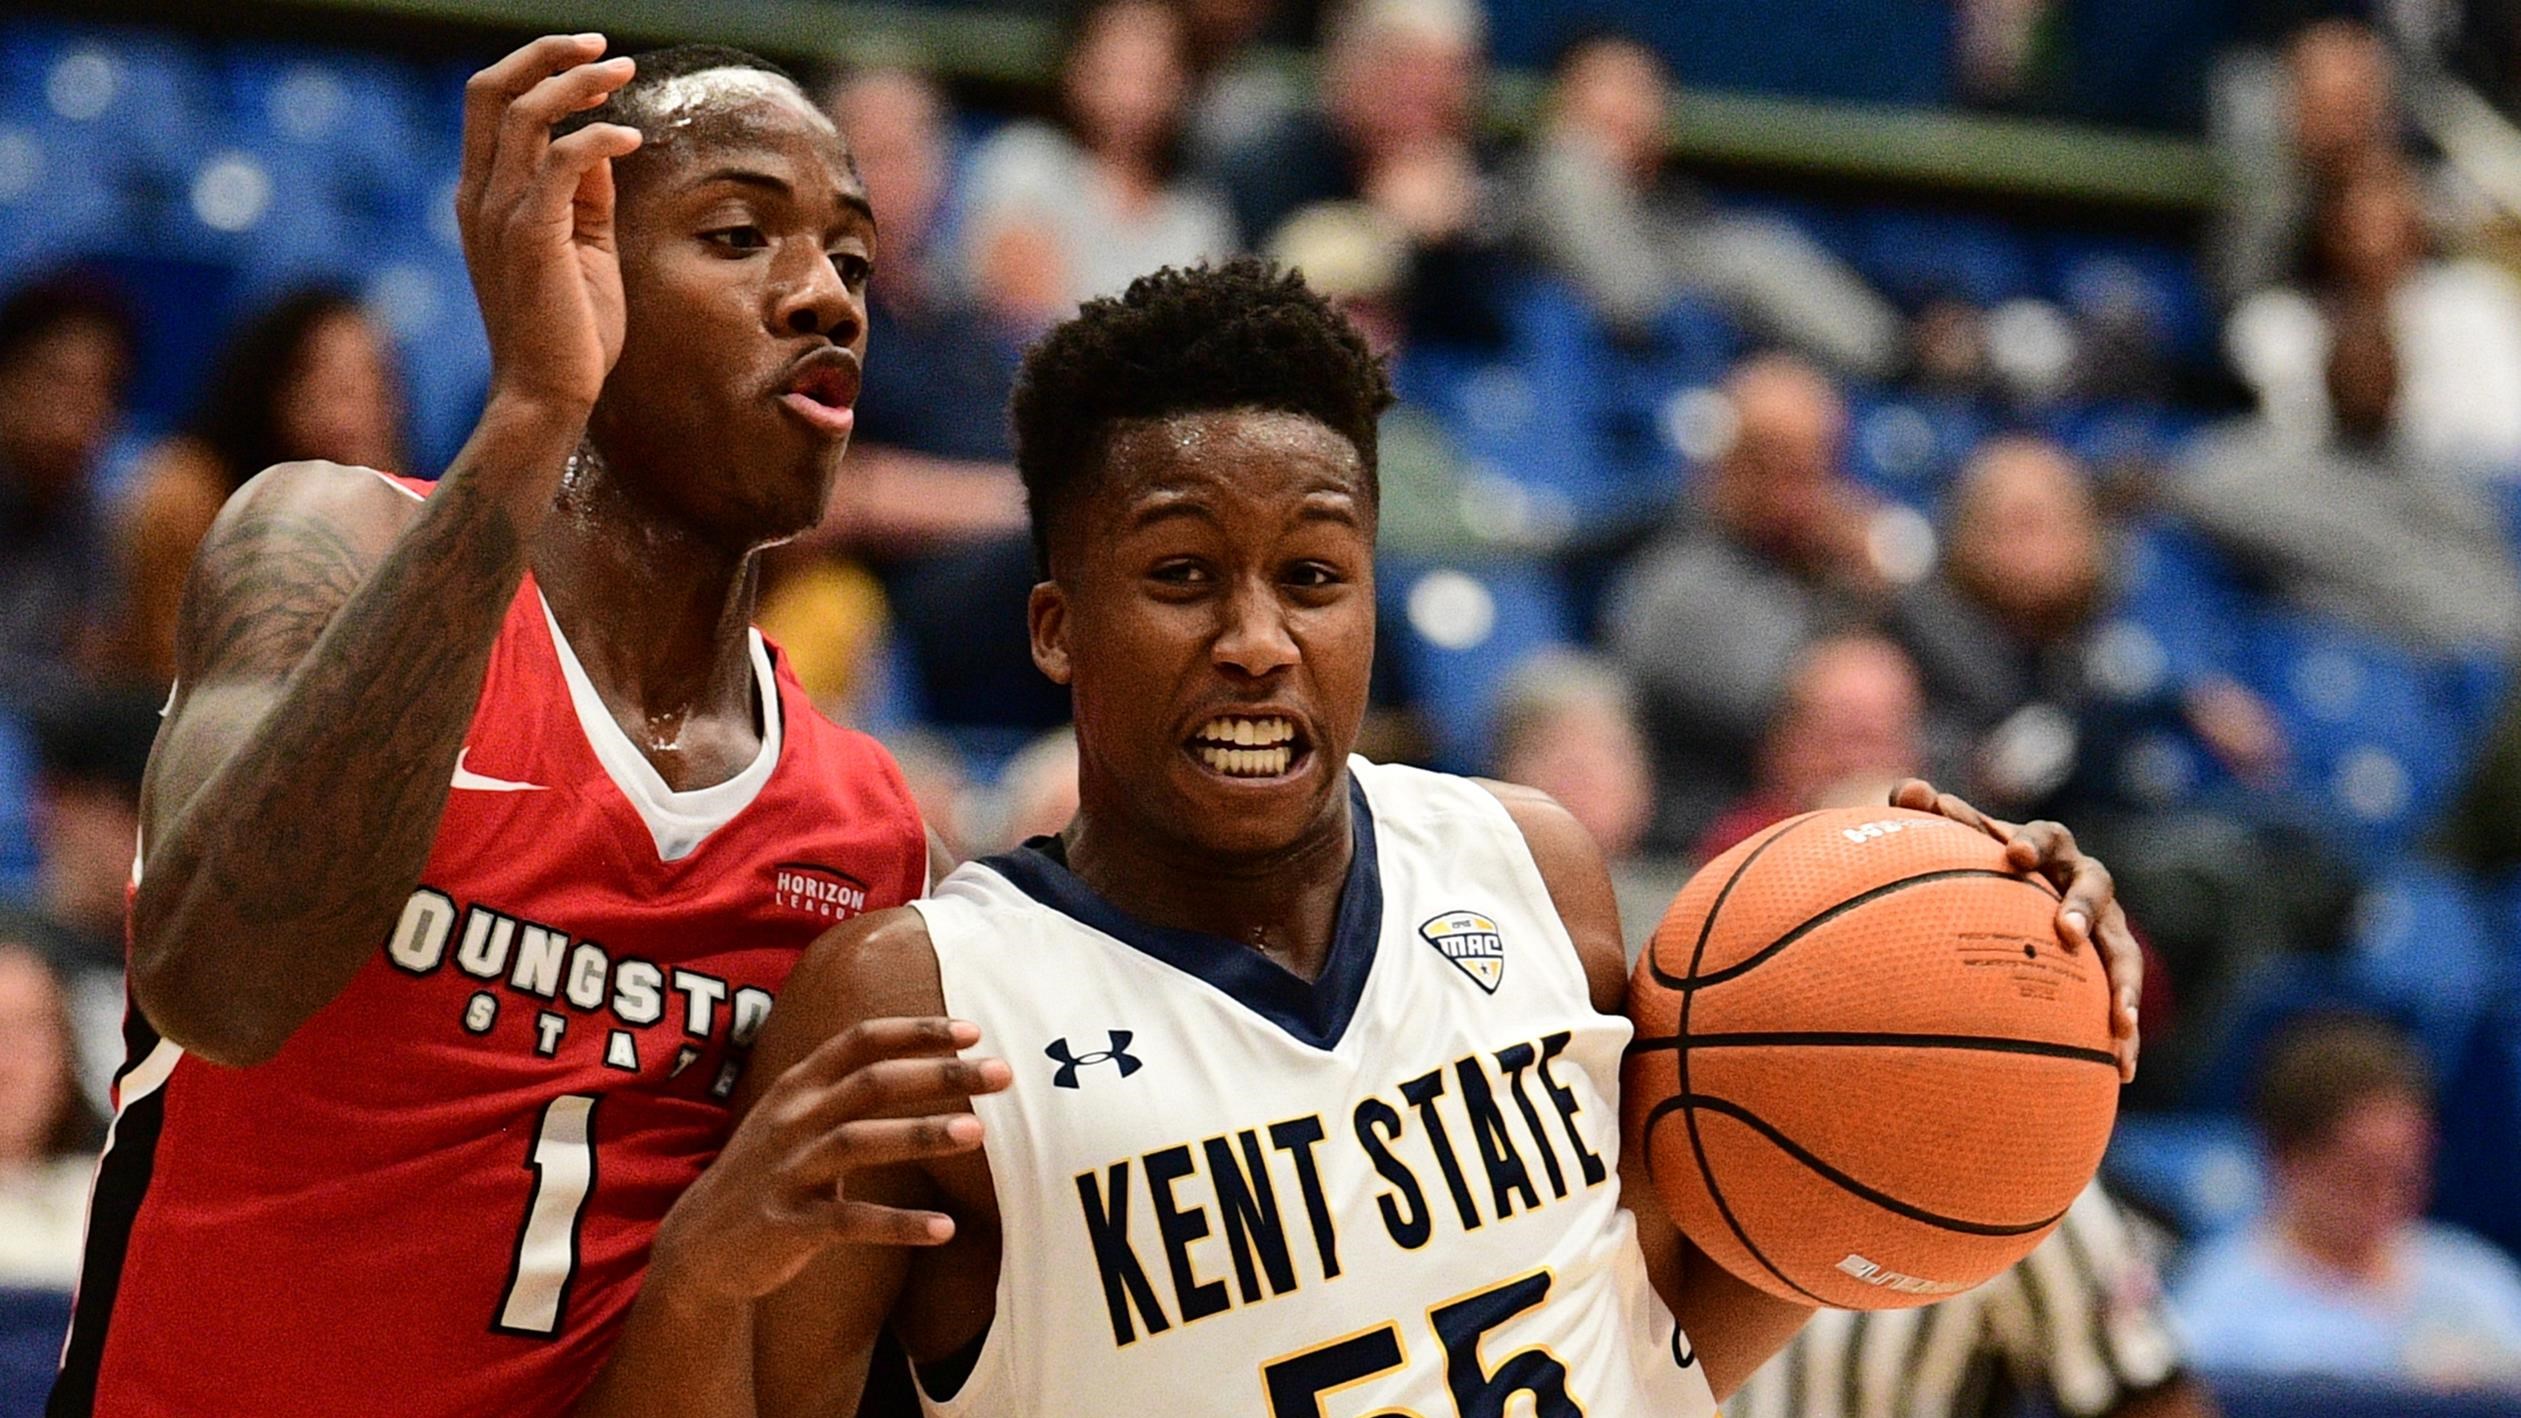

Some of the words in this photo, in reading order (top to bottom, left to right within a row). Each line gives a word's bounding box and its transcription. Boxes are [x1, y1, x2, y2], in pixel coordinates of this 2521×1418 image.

[775, 892, 861, 920] LEAGU
[777, 872, 865, 911] HORIZON
[386, 888, 775, 1045] OUNGSTO
[1436, 933, 1503, 957] MAC
[492, 1094, 601, 1338] 1
[1074, 1113, 1342, 1348] KENT
[1352, 1030, 1608, 1251] STATE
